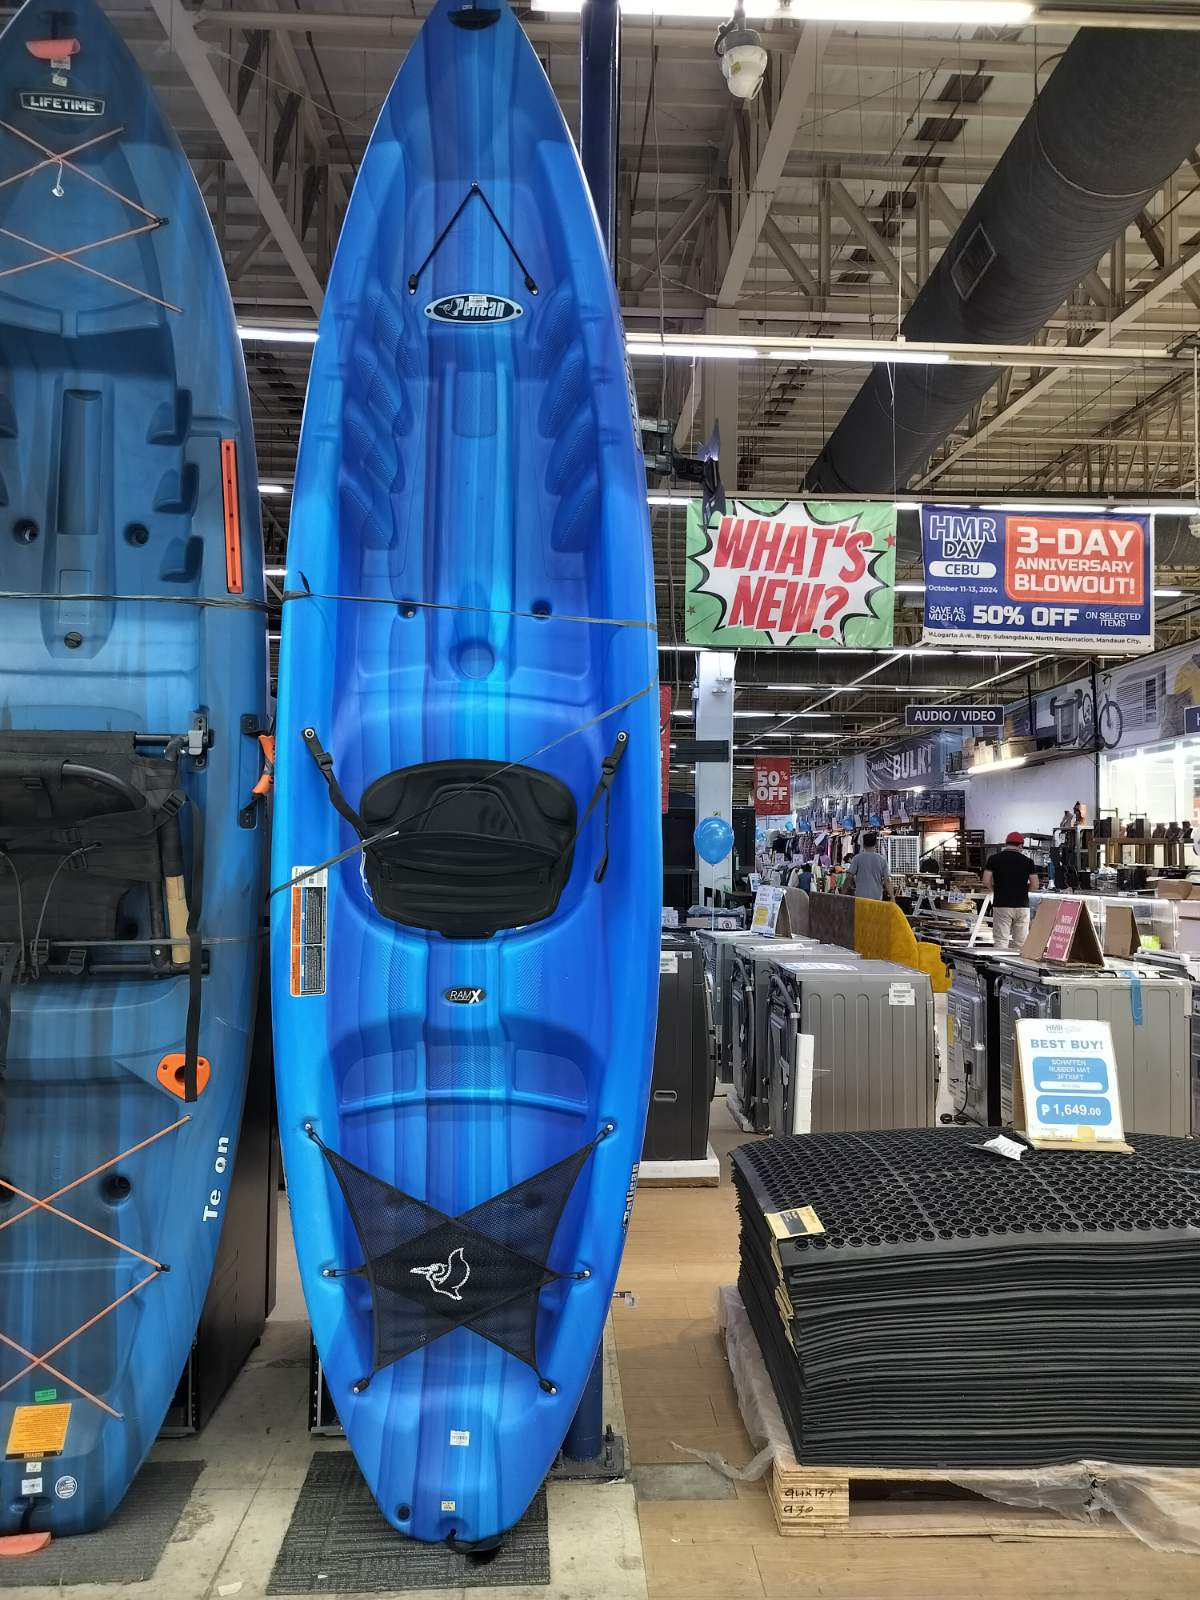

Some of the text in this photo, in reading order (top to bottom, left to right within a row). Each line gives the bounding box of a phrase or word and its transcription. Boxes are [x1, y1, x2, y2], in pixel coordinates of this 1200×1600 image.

[30, 96, 96, 112] LIFETIME
[929, 515, 997, 542] HMR
[943, 539, 985, 559] DAY
[1016, 526, 1135, 557] 3-DAY
[713, 517, 873, 583] WHAT'S
[944, 563, 980, 576] CEBU
[1014, 557, 1134, 574] ANNIVERSARY
[928, 584, 959, 593] October
[959, 585, 978, 594] 11-13,
[1014, 573, 1136, 595] BLOWOUT!
[728, 575, 850, 638] NEW?
[929, 605, 965, 615] SAVE AS
[928, 613, 967, 622] MUCH AS
[972, 604, 1080, 627] 50% OFF
[1085, 611, 1141, 621] ON SELECTED
[1100, 619, 1127, 627] ITEMS
[914, 710, 996, 722] AUDIO / VIDEO
[893, 744, 932, 781] BULK!
[757, 770, 788, 787] 50%
[756, 786, 788, 801] OFF
[1030, 1039, 1104, 1050] BEST BUY!
[1053, 1103, 1102, 1117] 1,649.00
